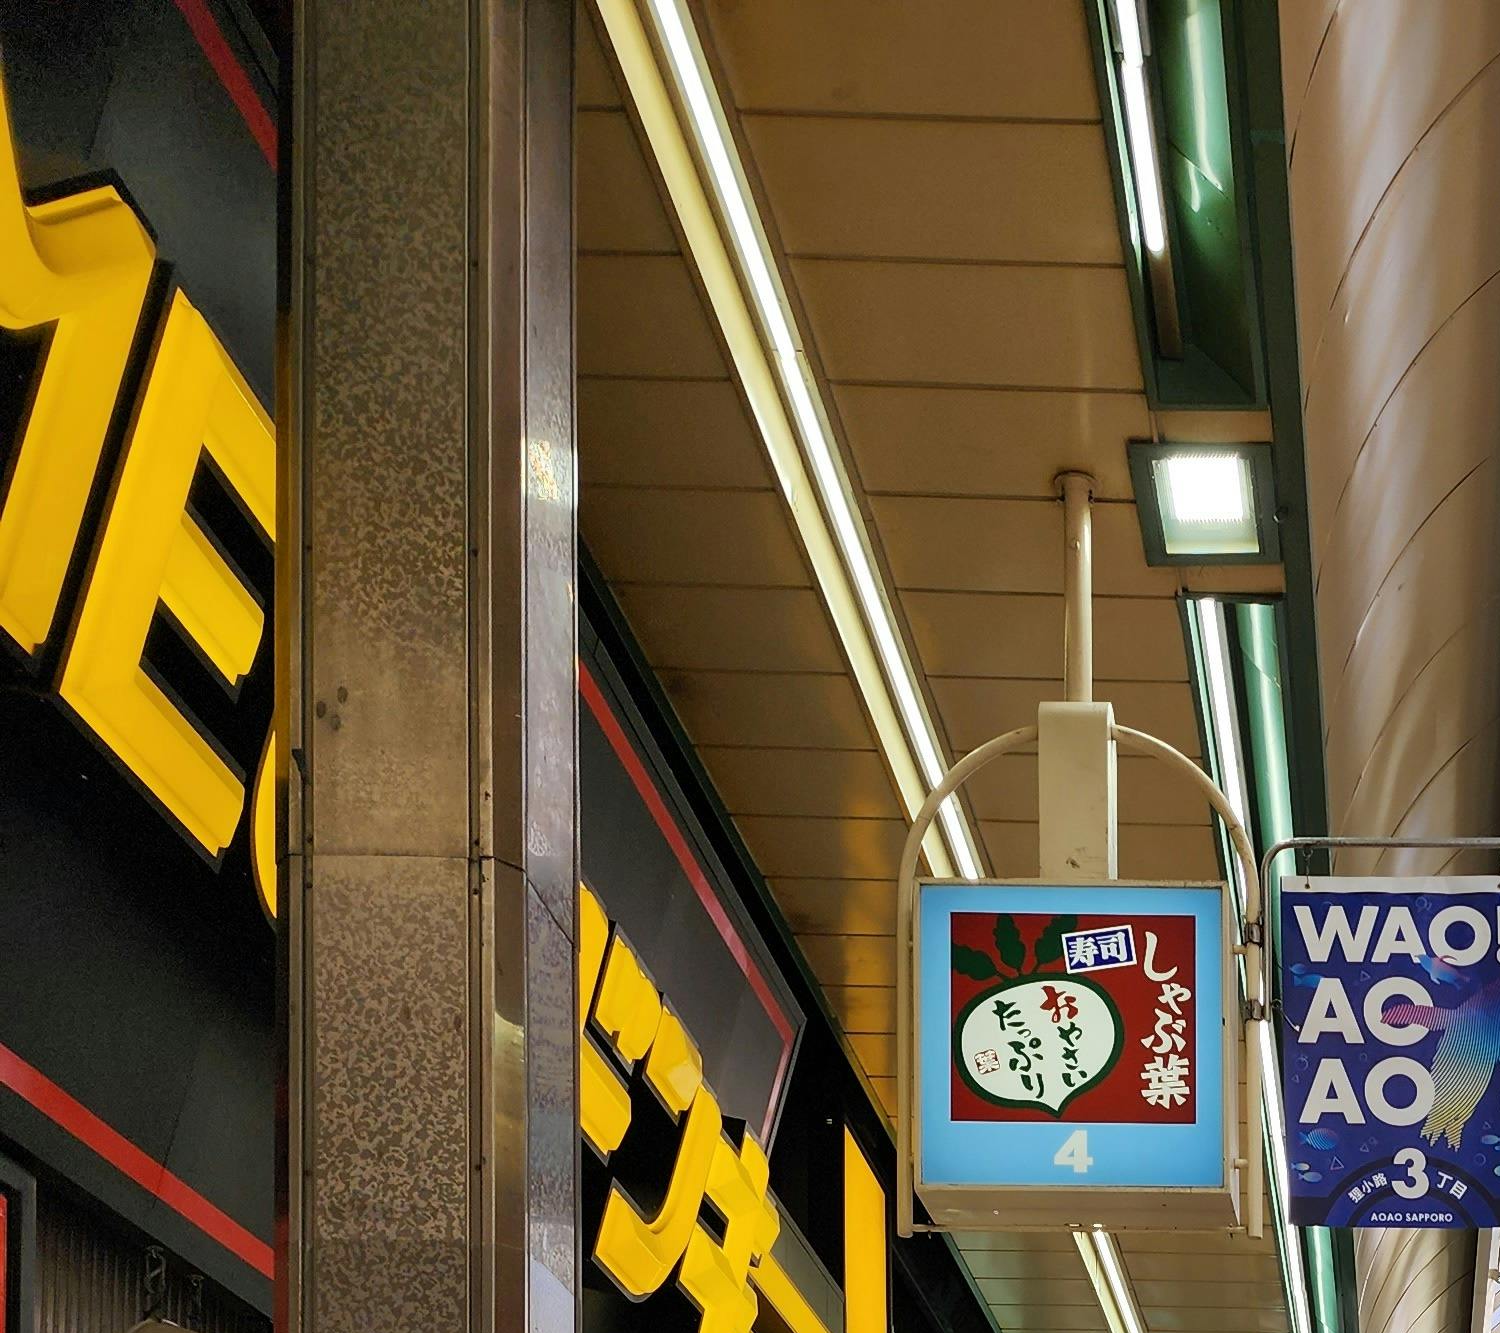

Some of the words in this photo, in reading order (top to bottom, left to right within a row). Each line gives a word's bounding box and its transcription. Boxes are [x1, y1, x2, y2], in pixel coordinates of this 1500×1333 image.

[1067, 930, 1131, 967] 寿司
[991, 999, 1044, 1100] たっぷり
[1038, 985, 1088, 1089] おやさい
[1140, 931, 1193, 1110] しゃぶ葉
[1298, 1057, 1437, 1126] AO
[1053, 1130, 1094, 1174] 4
[1348, 1171, 1388, 1204] 狸小路
[1390, 1146, 1430, 1201] 3
[1436, 1173, 1469, 1201] 丁目
[1370, 1212, 1402, 1223] AOAO
[1405, 1211, 1454, 1223] SAPPORO
